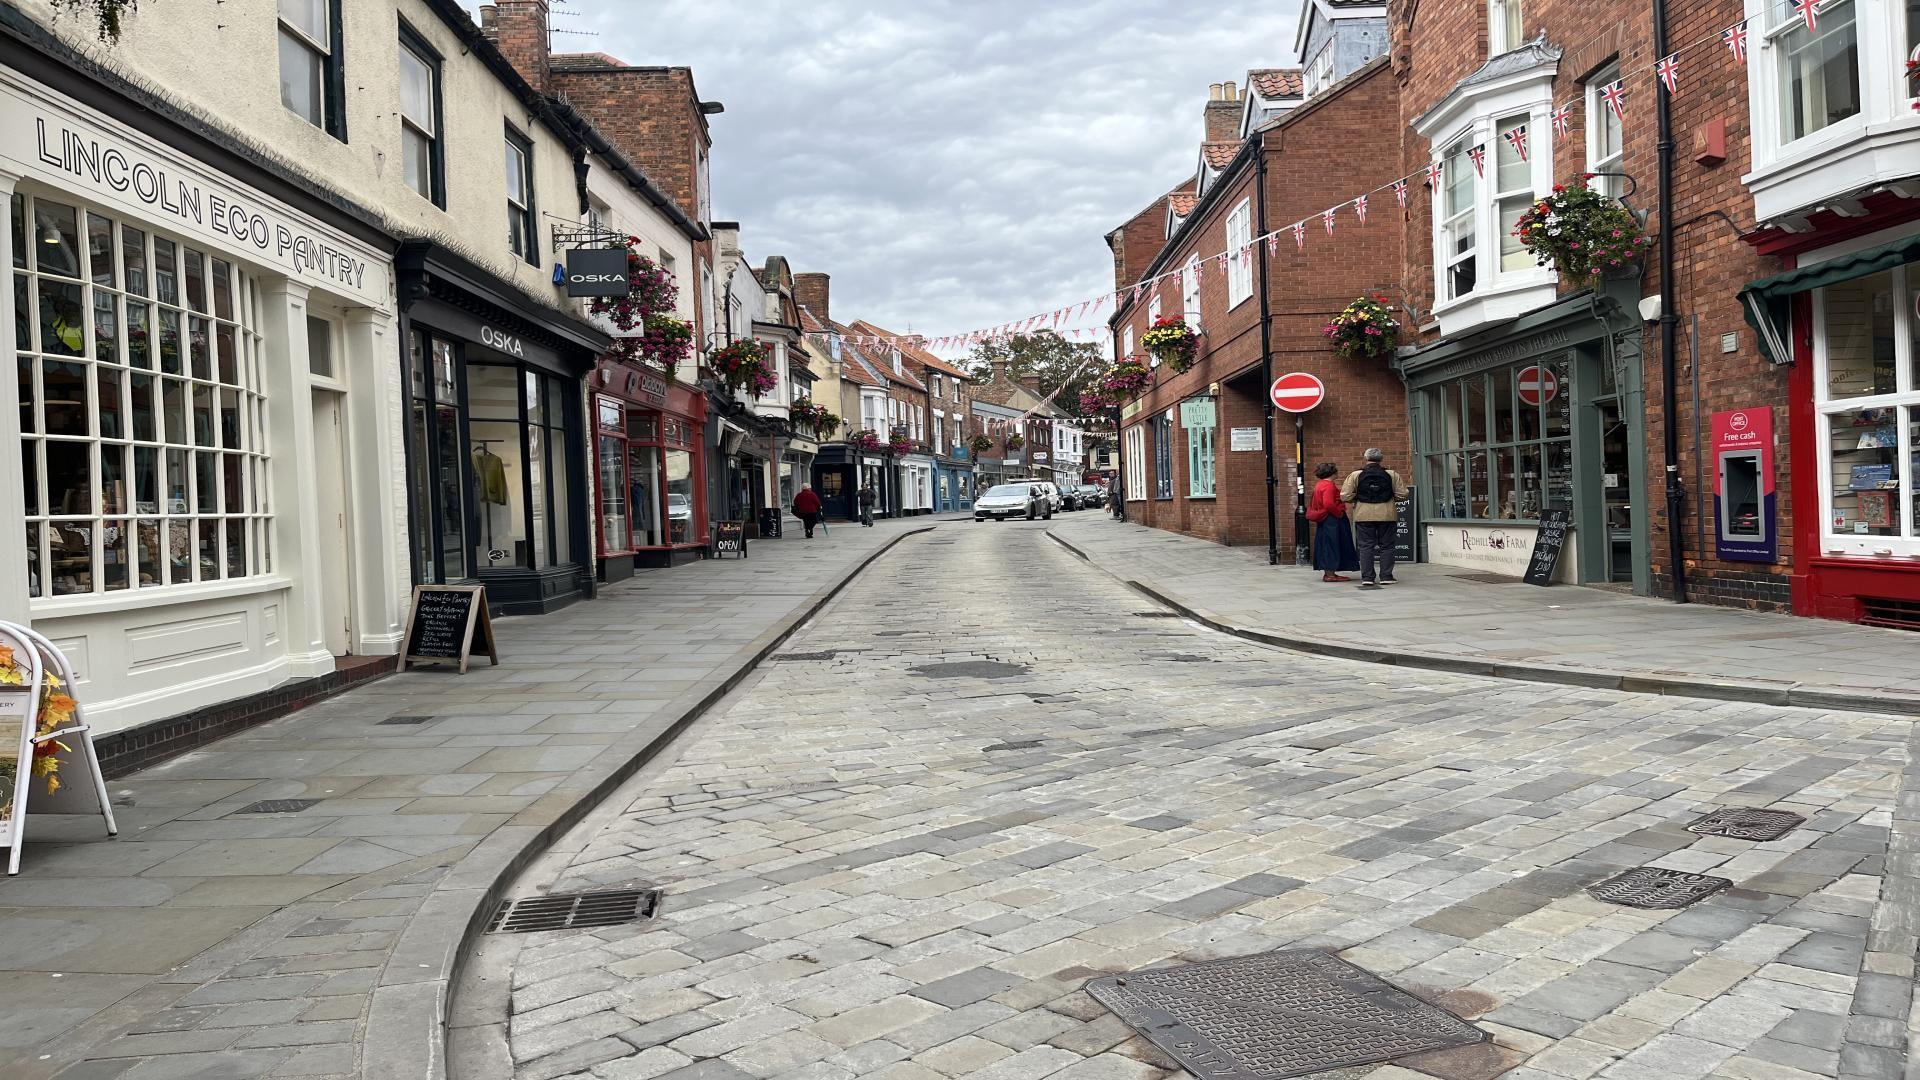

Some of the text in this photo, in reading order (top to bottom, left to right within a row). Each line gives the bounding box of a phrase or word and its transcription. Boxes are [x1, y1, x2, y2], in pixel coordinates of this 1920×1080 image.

[36, 117, 365, 289] LINCOLN ECO PANTRY
[570, 274, 625, 283] OSKA
[480, 325, 524, 357] OSKA
[1472, 354, 1493, 370] FARM
[1494, 348, 1514, 361] SHOP
[1517, 344, 1527, 356] IN
[1529, 335, 1546, 352] THE
[1548, 329, 1569, 347] BAIL
[1724, 431, 1756, 441] Free cash
[1550, 511, 1562, 521] HOT
[718, 540, 739, 550] OPEN
[1461, 529, 1528, 550] REDHILL FARM
